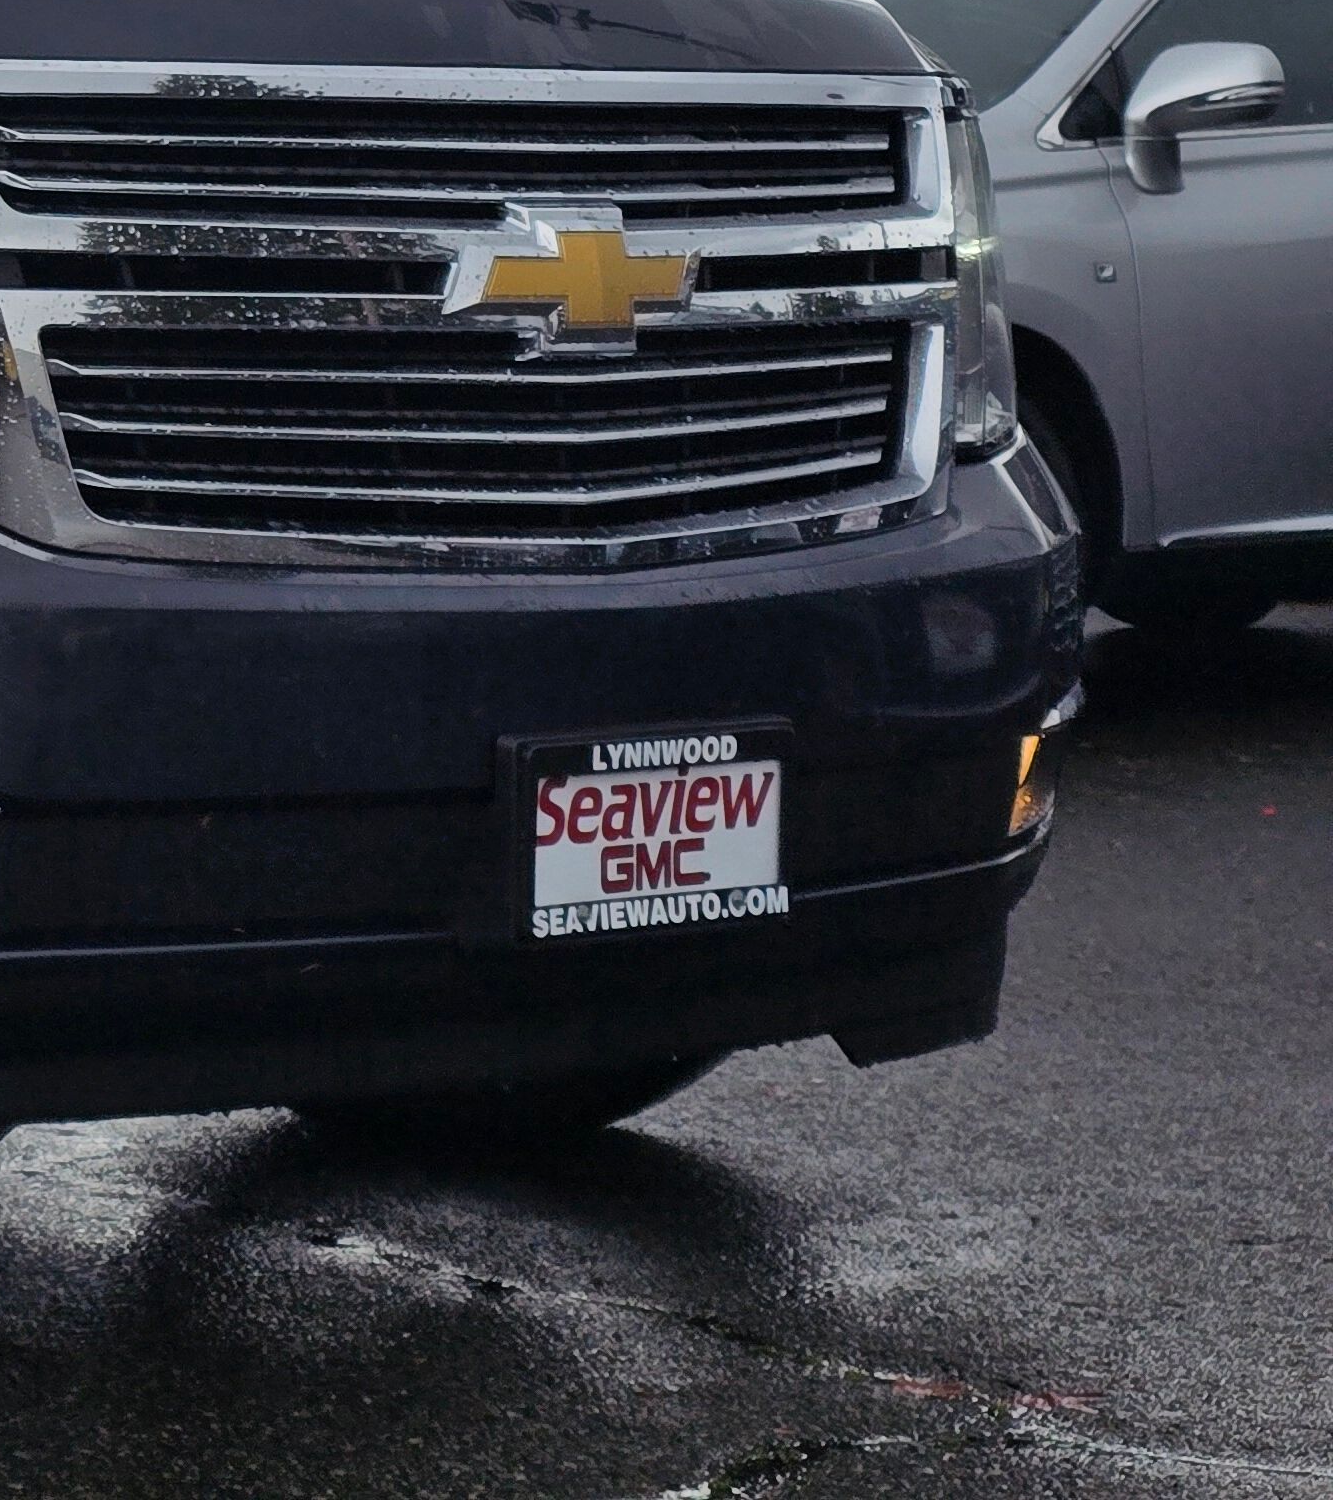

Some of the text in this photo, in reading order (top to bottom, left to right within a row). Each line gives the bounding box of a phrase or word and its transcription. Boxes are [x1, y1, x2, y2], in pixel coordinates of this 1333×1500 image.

[592, 735, 738, 770] LYNNWOOD
[536, 767, 775, 847] Seaview
[600, 837, 711, 894] GMC
[532, 886, 790, 938] SEAVIEWAUTO.COM
